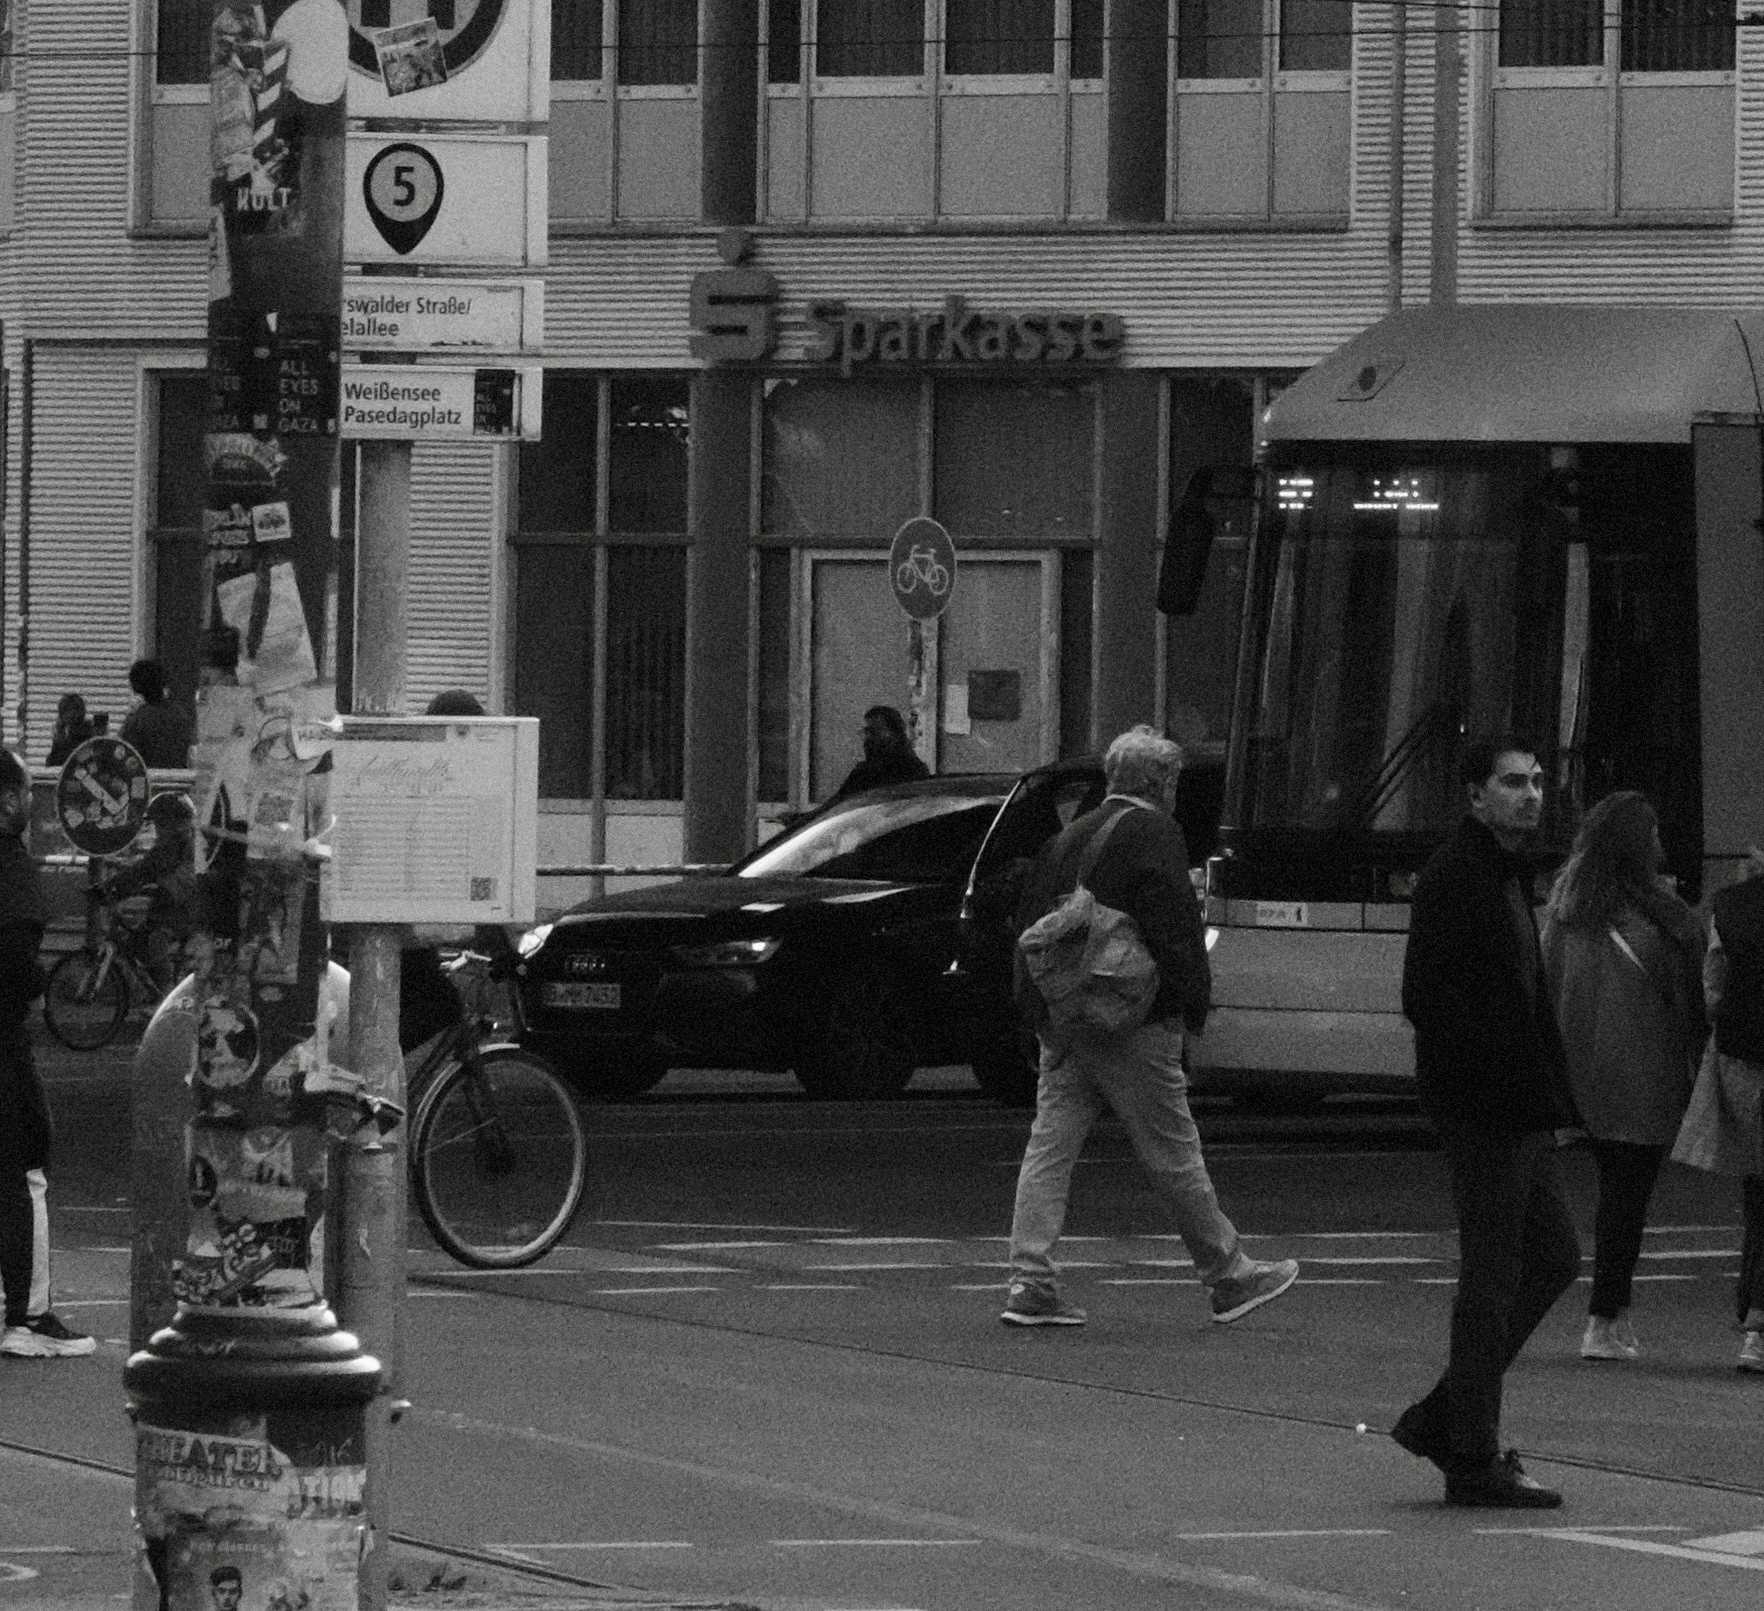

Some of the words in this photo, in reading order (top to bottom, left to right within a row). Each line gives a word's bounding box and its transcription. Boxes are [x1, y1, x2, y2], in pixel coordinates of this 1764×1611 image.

[393, 166, 416, 207] 5
[805, 294, 1125, 378] Sparkasse
[280, 359, 309, 375] ALL
[279, 377, 319, 395] EYES
[344, 381, 443, 402] Weißensee
[278, 397, 301, 414] ON
[277, 416, 319, 433] GAZA
[344, 405, 463, 428] Pasedagplatz
